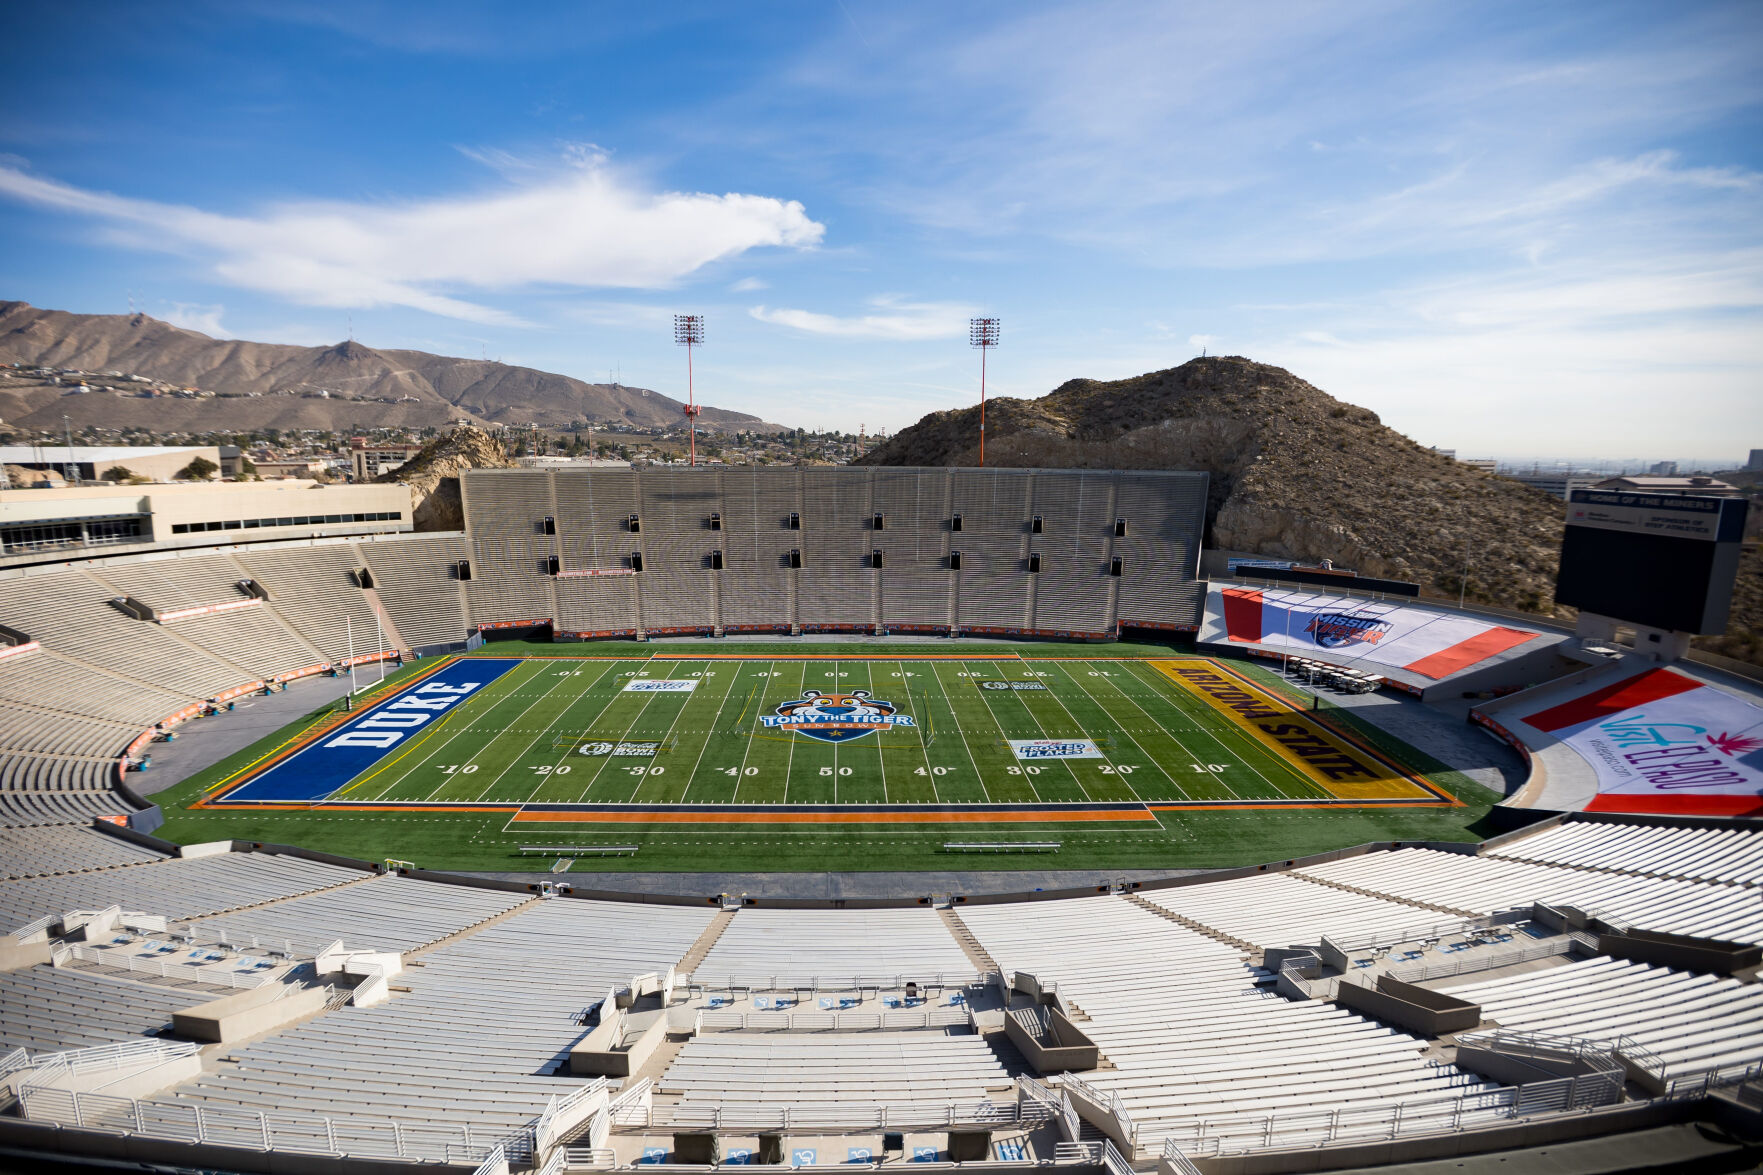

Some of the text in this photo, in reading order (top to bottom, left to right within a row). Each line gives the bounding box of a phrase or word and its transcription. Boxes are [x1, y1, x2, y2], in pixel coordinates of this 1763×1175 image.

[1588, 494, 1715, 510] HOME OF THE MINERS
[1317, 613, 1394, 633] MISSION
[1304, 620, 1385, 645] TIGER
[322, 682, 481, 748] DUKE
[760, 715, 819, 727] TONY
[851, 715, 916, 727] TIGER
[1171, 668, 1285, 719] ARIZONA
[1258, 724, 1382, 780] STATE
[1020, 743, 1086, 753] FROSTED
[1025, 750, 1083, 758] FLAKES
[442, 765, 479, 774] 10
[534, 765, 571, 775] 20
[629, 766, 665, 776] 30
[724, 767, 759, 776] 40
[818, 767, 853, 776] 50
[913, 767, 947, 776] 40
[1006, 766, 1041, 775] 30
[1098, 765, 1133, 775] 20
[1190, 763, 1225, 773] 10
